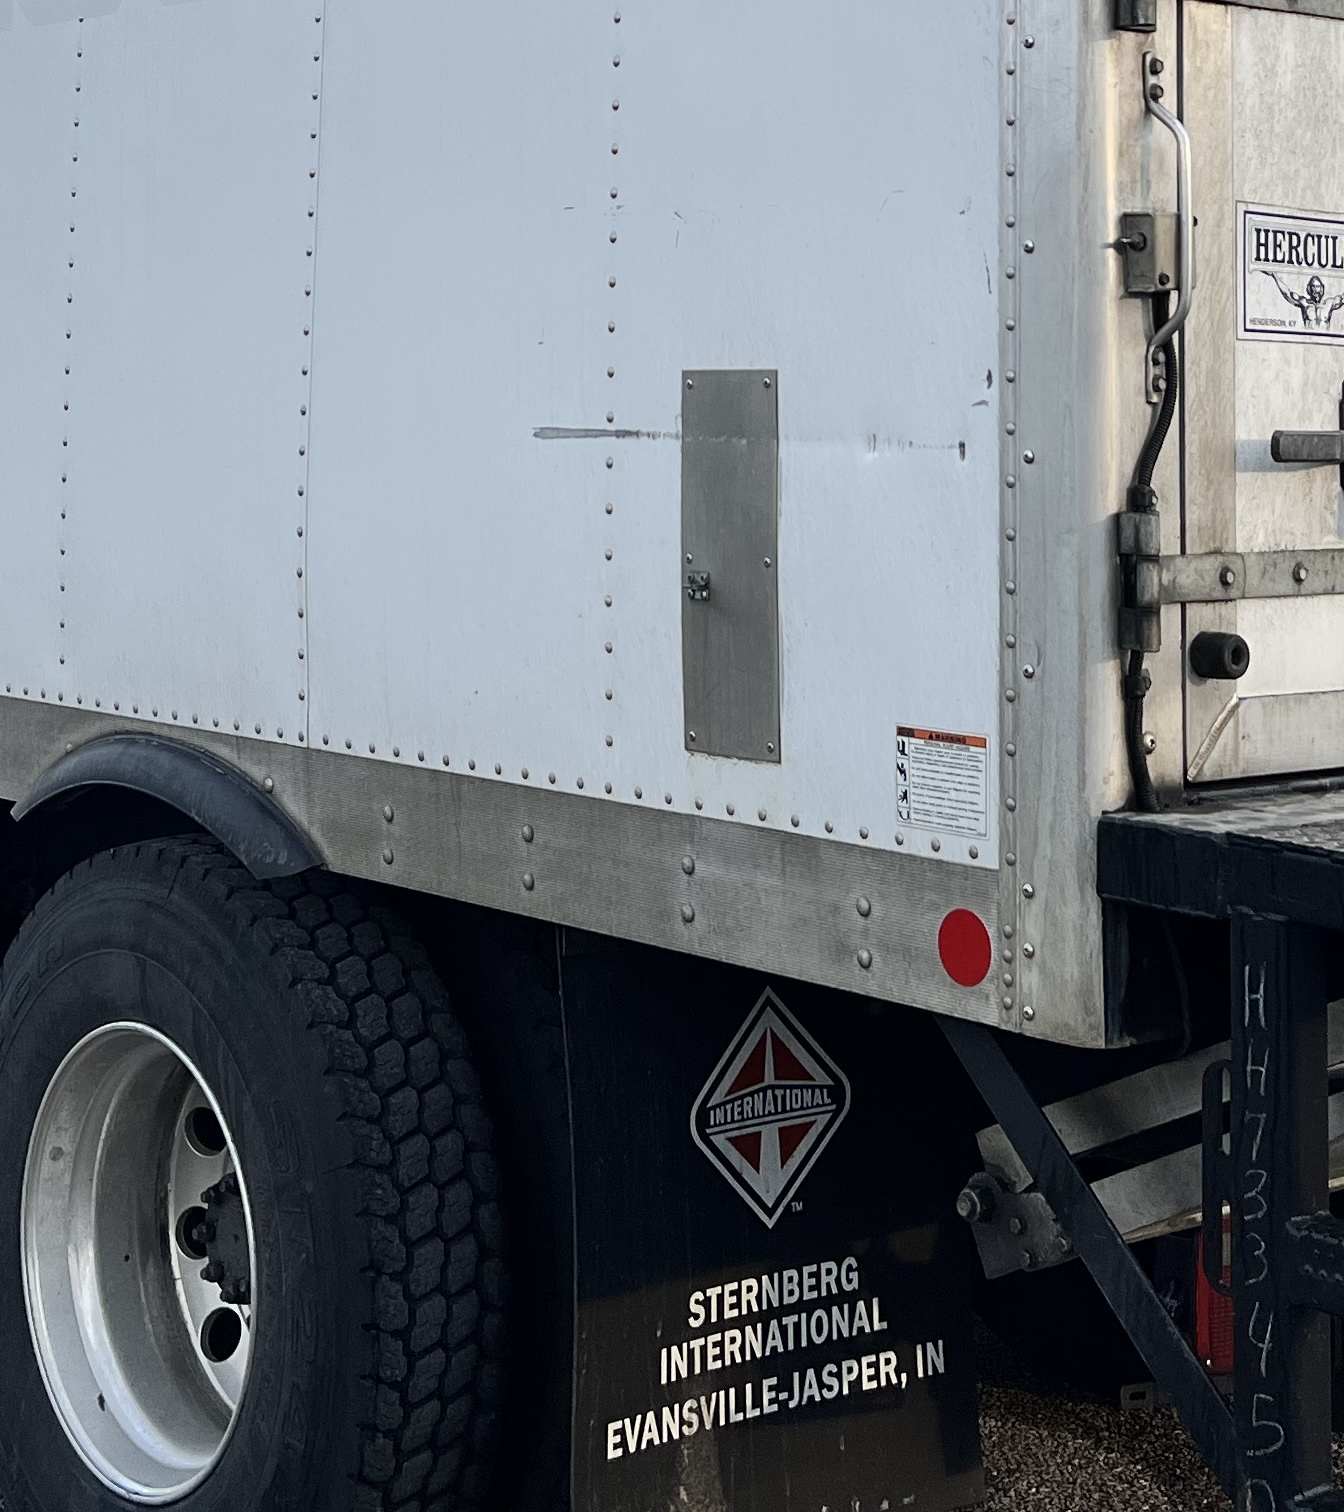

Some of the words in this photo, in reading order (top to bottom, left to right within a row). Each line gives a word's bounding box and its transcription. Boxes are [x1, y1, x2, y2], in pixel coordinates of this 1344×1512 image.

[709, 1088, 832, 1127] INTERNATIONAL
[687, 1256, 860, 1328] STERNBERG
[660, 1297, 888, 1385] INTERNATIONAL
[606, 1350, 908, 1460] EVANSVILLE-JASPER,
[916, 1339, 945, 1379] IN
